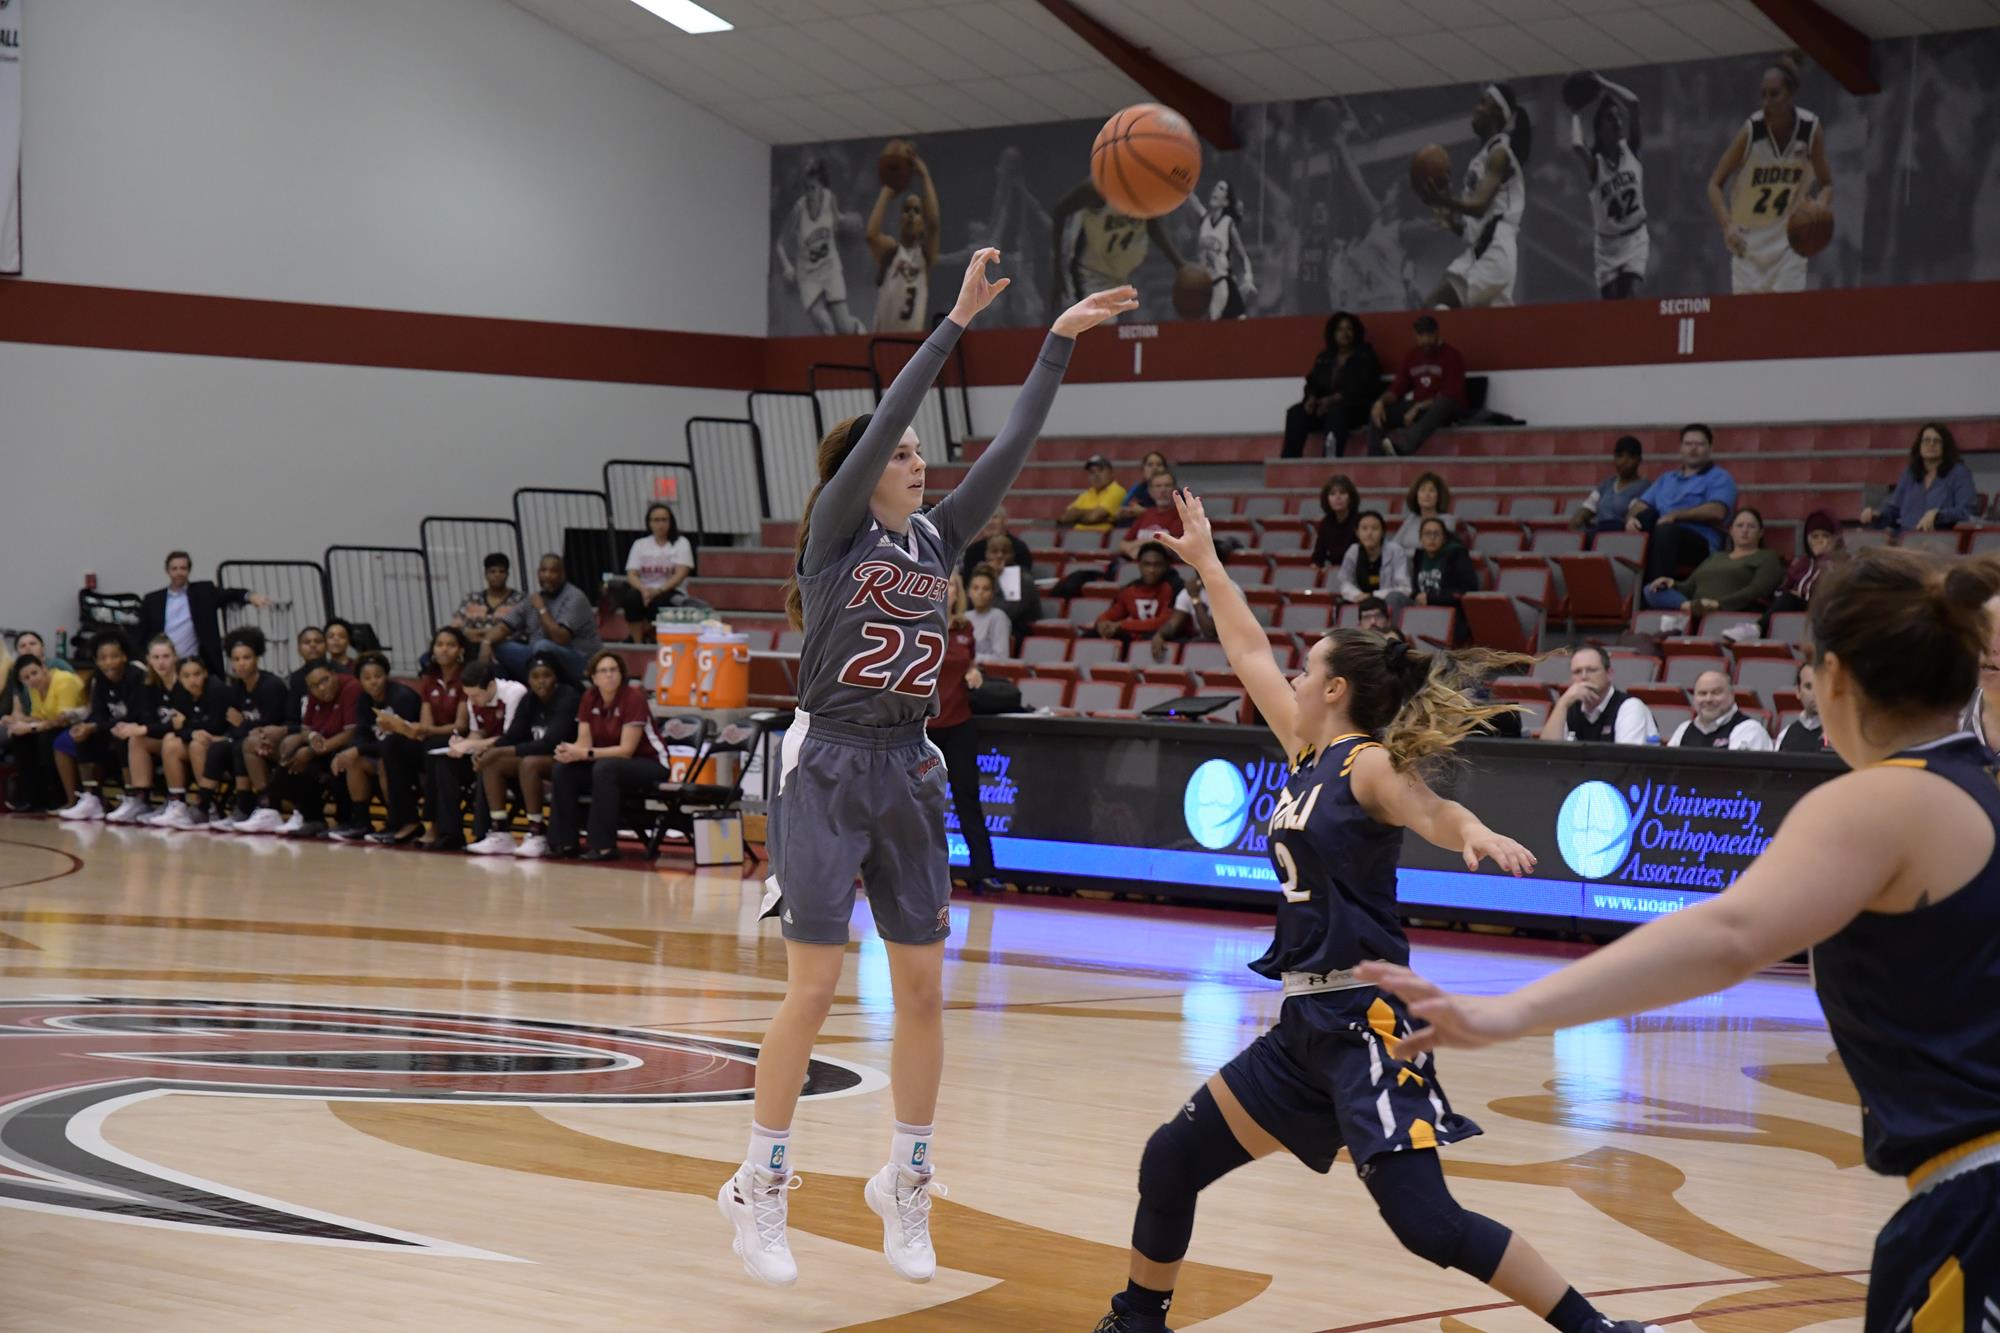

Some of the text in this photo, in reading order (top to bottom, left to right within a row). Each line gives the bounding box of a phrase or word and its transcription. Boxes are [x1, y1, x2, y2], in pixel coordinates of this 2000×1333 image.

[1753, 188, 1791, 217] 24
[1660, 297, 1711, 315] SECTION
[837, 621, 945, 698] 22
[1653, 784, 1762, 830] University
